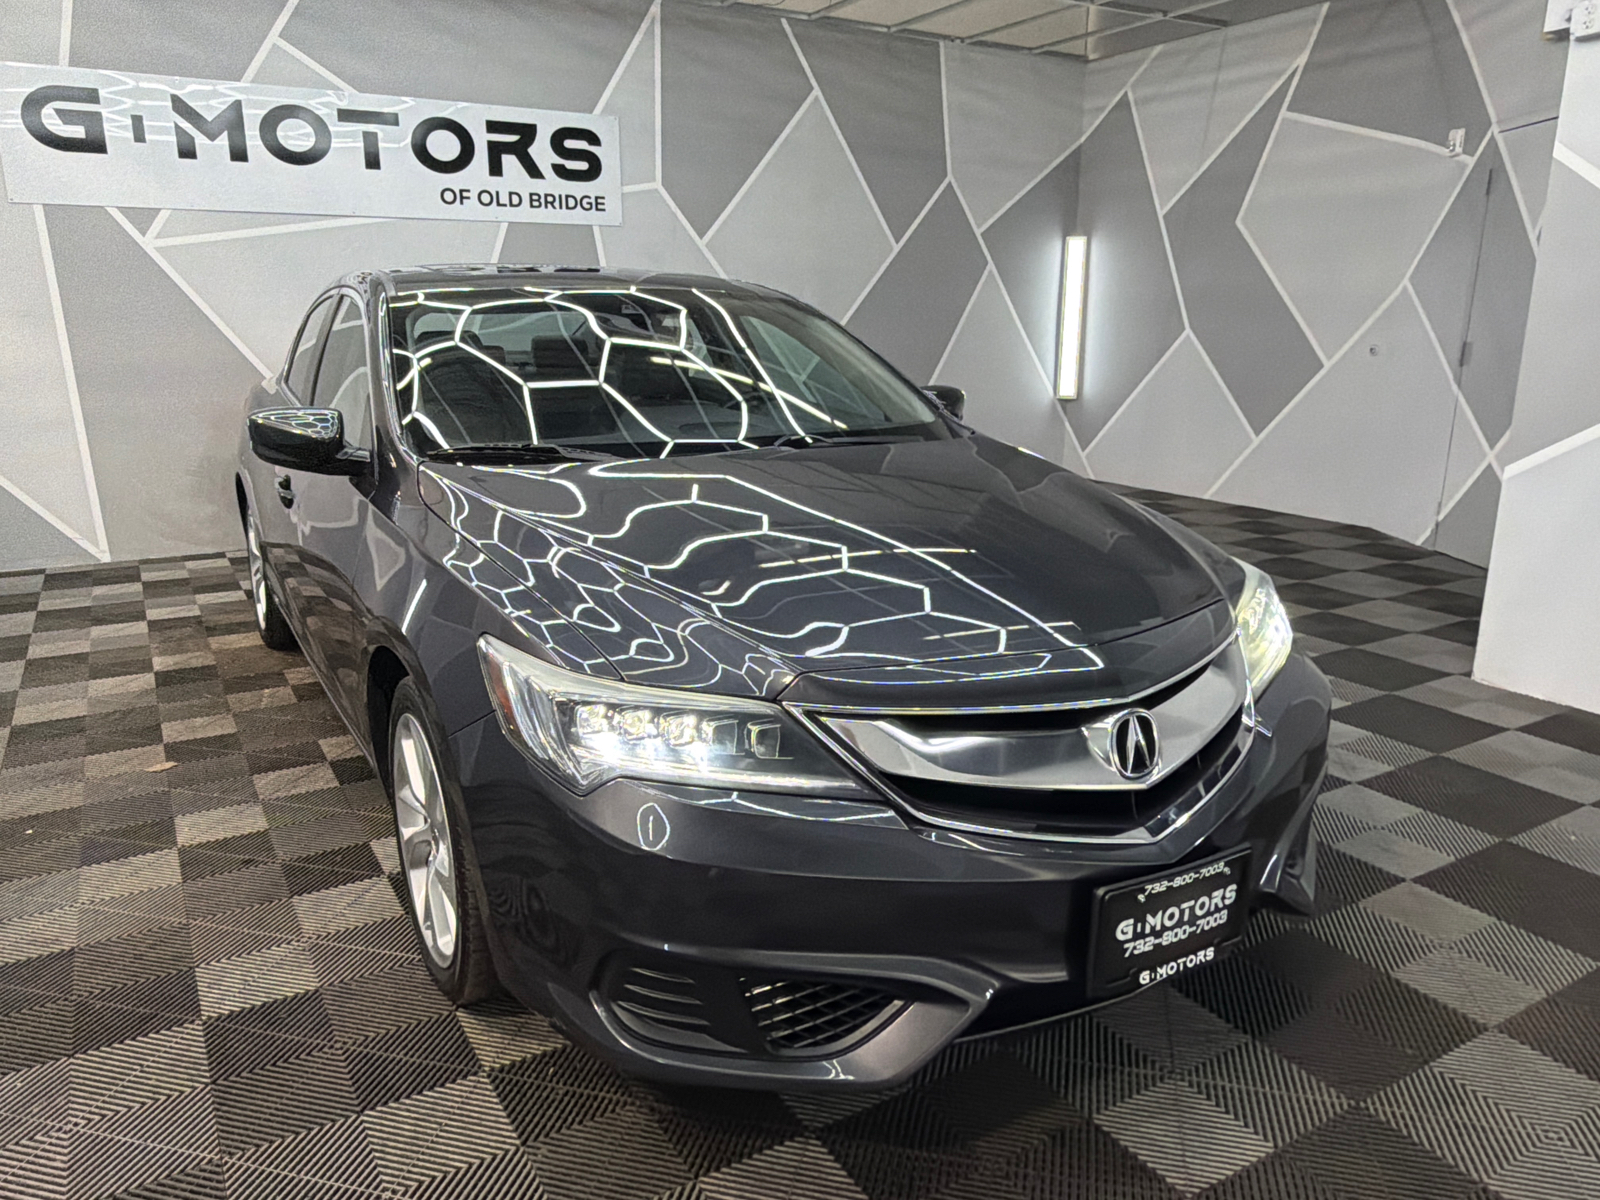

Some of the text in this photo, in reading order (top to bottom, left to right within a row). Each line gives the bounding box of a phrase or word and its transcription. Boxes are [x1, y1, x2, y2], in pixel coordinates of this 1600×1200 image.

[439, 187, 606, 212] OF OLD BRIDGE
[1143, 861, 1225, 896] 732-800-7003
[1123, 909, 1228, 958] 732-800-7003
